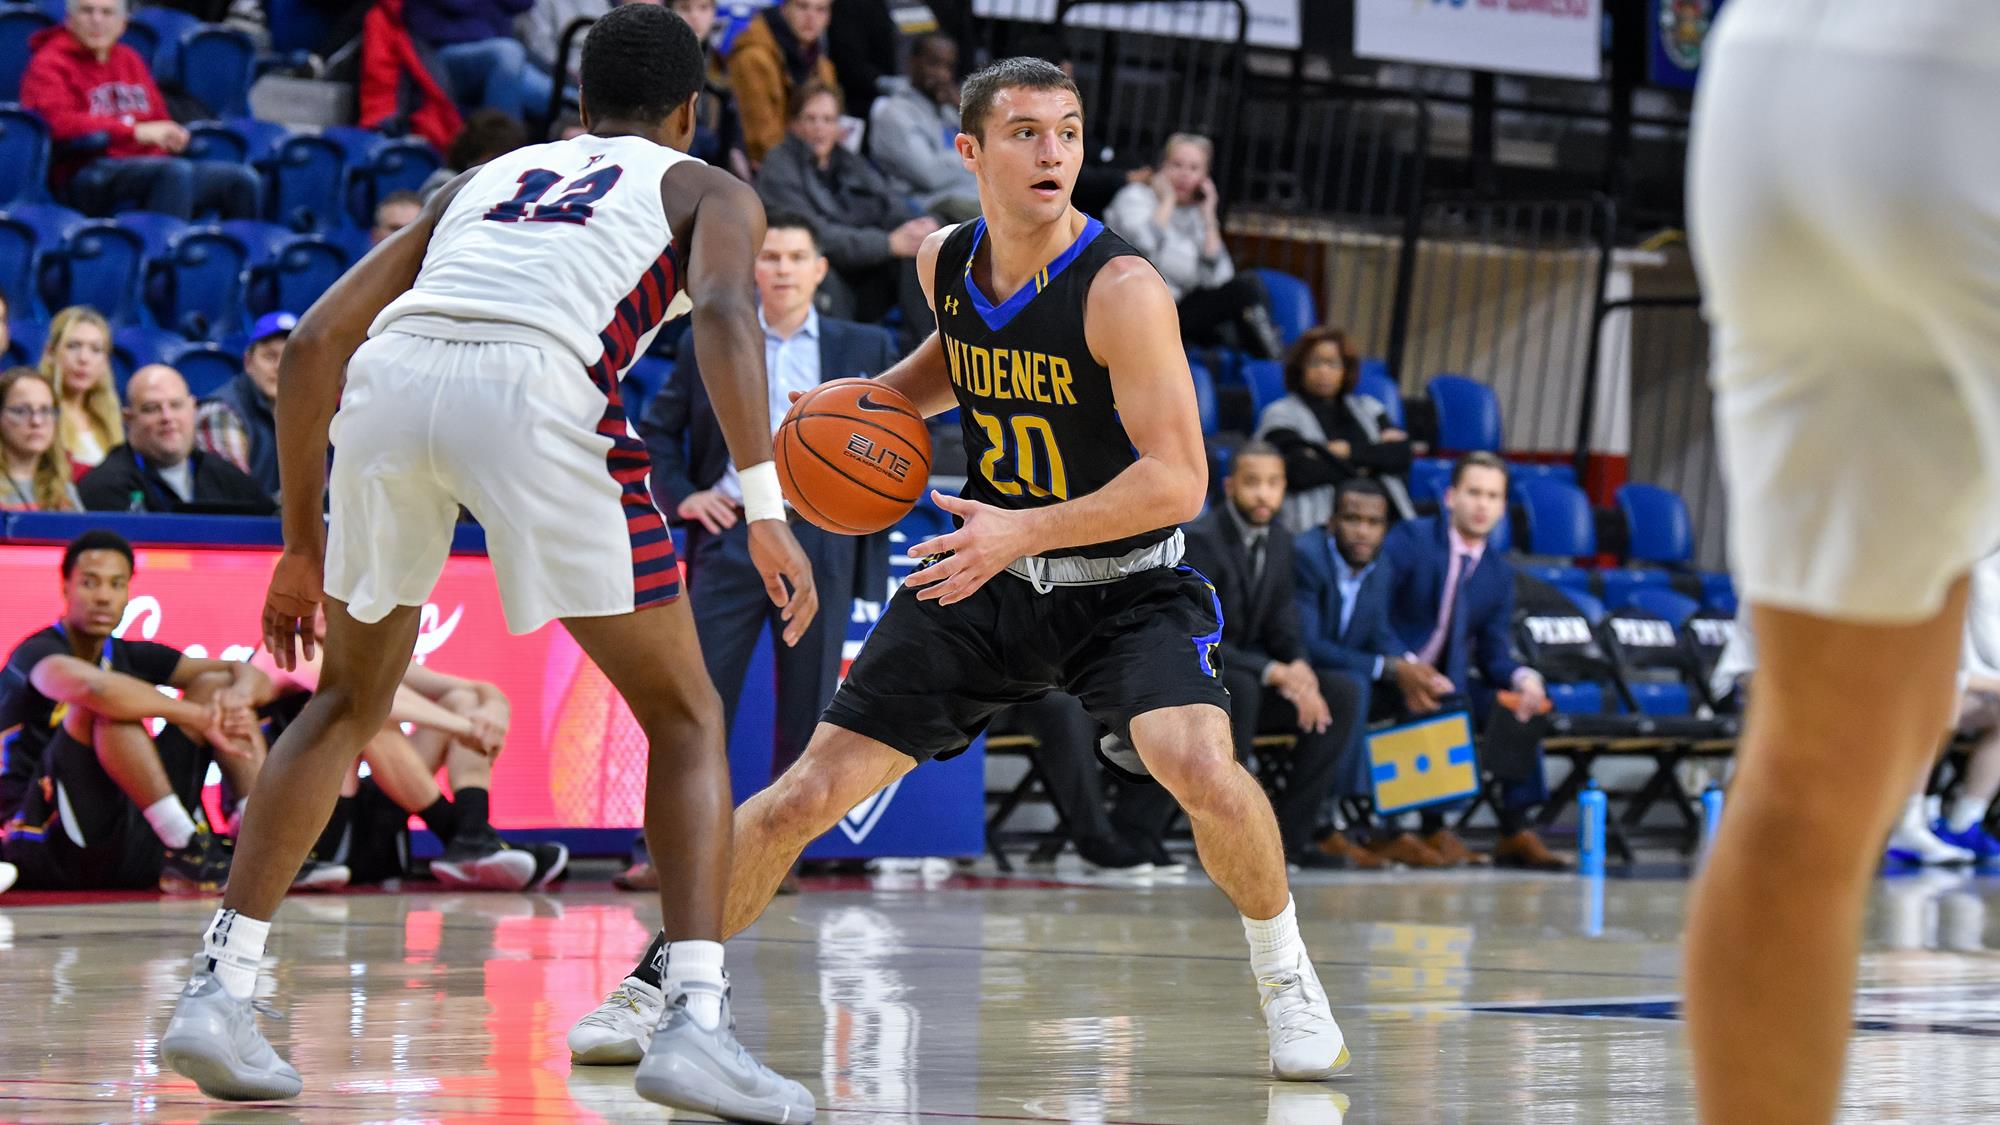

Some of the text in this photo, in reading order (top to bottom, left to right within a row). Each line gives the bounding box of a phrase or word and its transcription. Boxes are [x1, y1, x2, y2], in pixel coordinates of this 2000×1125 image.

[482, 164, 624, 226] 12
[944, 332, 1078, 405] WIDENER
[847, 432, 912, 478] ELITE
[972, 408, 1070, 501] 20
